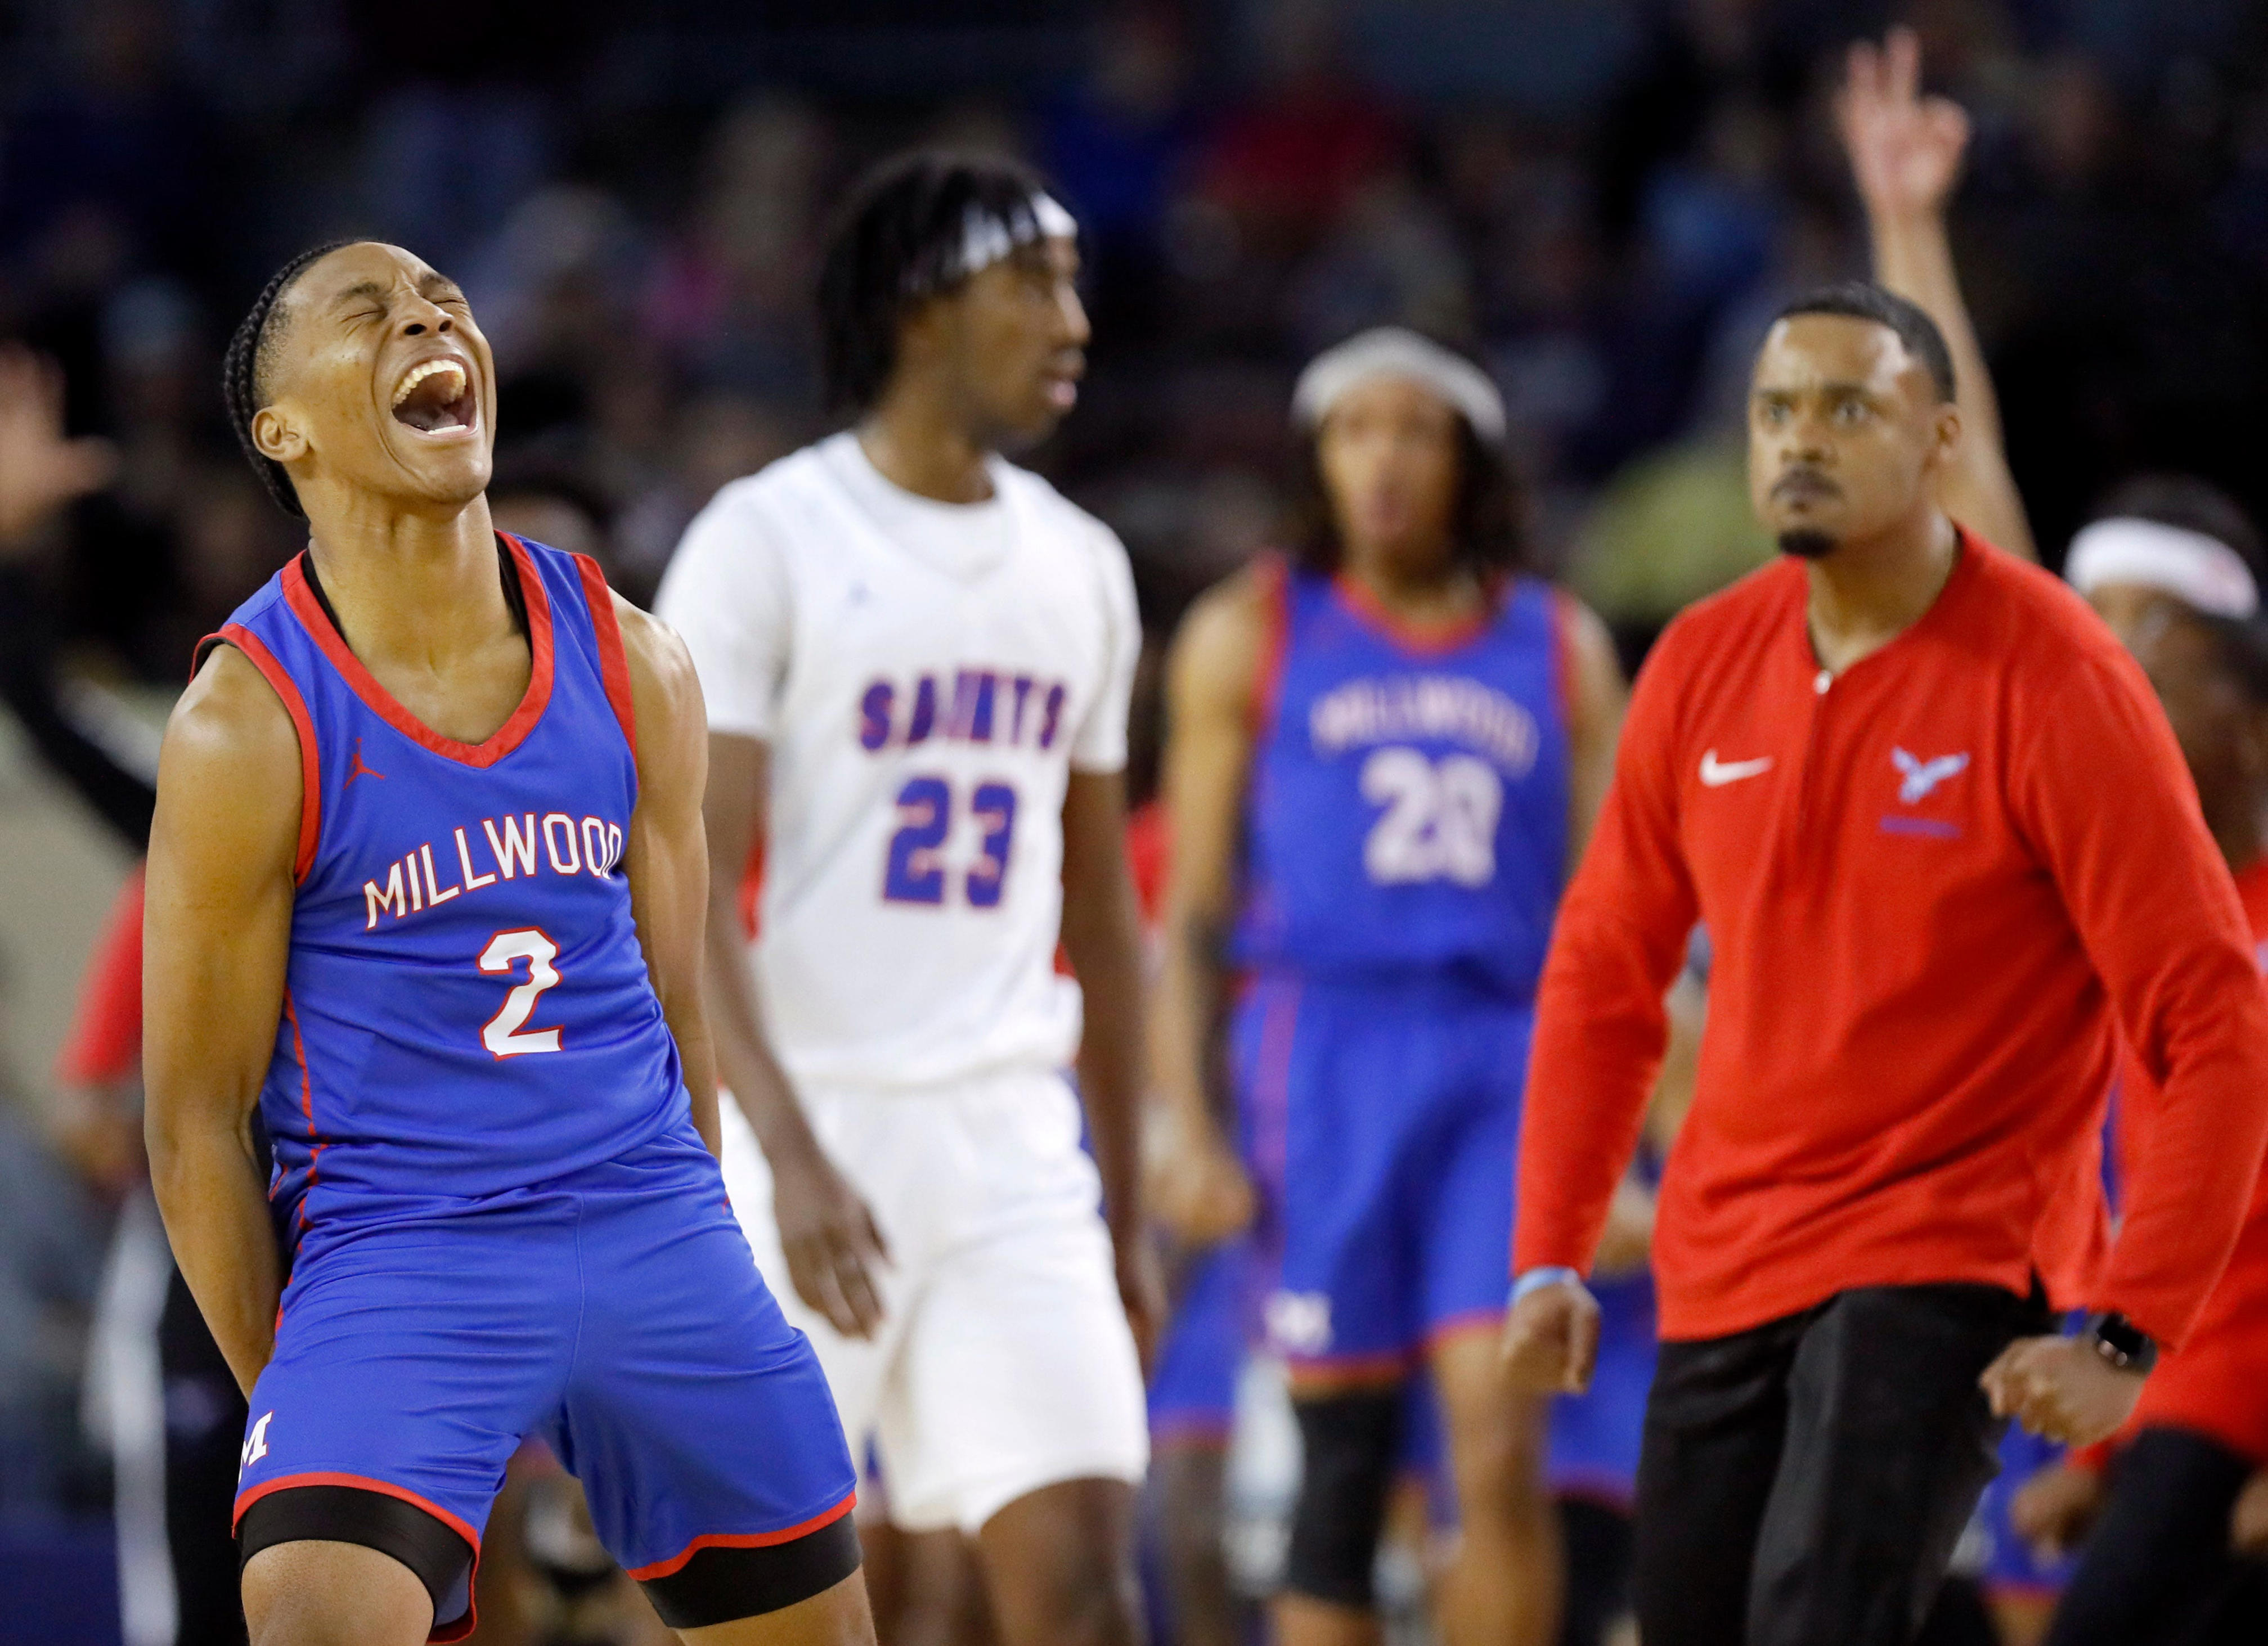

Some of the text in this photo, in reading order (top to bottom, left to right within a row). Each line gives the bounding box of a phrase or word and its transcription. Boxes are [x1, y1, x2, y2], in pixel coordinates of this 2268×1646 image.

[363, 812, 622, 930] MILLWOOD
[883, 775, 1016, 909] 23
[476, 925, 564, 1062] 2
